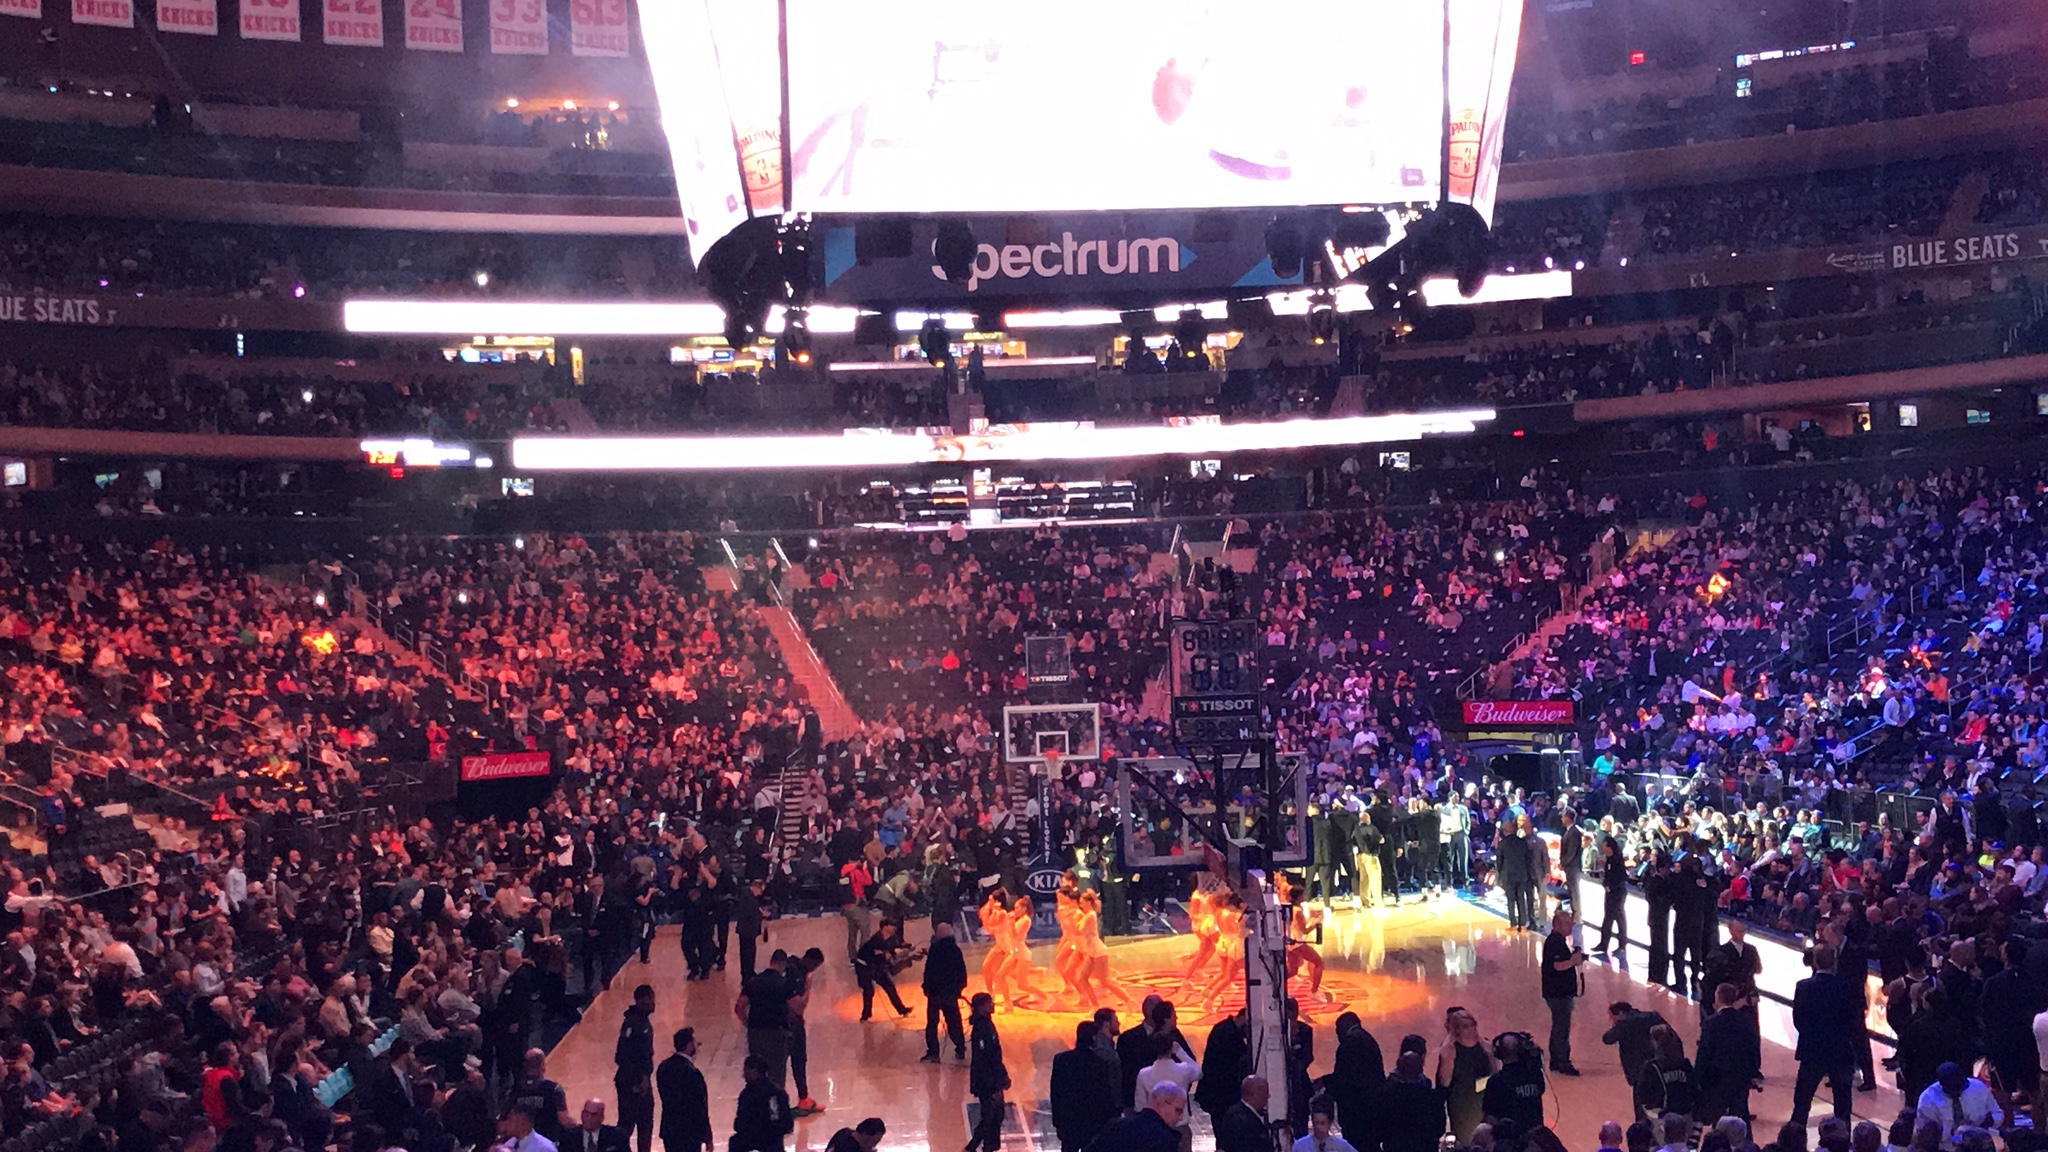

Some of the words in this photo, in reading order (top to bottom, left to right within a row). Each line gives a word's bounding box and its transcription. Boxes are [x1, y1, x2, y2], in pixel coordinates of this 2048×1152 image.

[161, 7, 214, 27] KNICKS
[243, 15, 298, 33] KNICKS
[327, 20, 380, 39] KNICKS
[408, 25, 460, 44] KNICKS
[493, 28, 547, 47] KNICKS
[1893, 240, 1948, 268] BLUE
[1953, 233, 2020, 262] SEATS
[33, 297, 101, 324] SEATS
[1201, 699, 1255, 711] TISSOT
[1470, 702, 1566, 723] Budweiser
[465, 758, 548, 778] Budweiser
[1034, 875, 1062, 888] KIA
